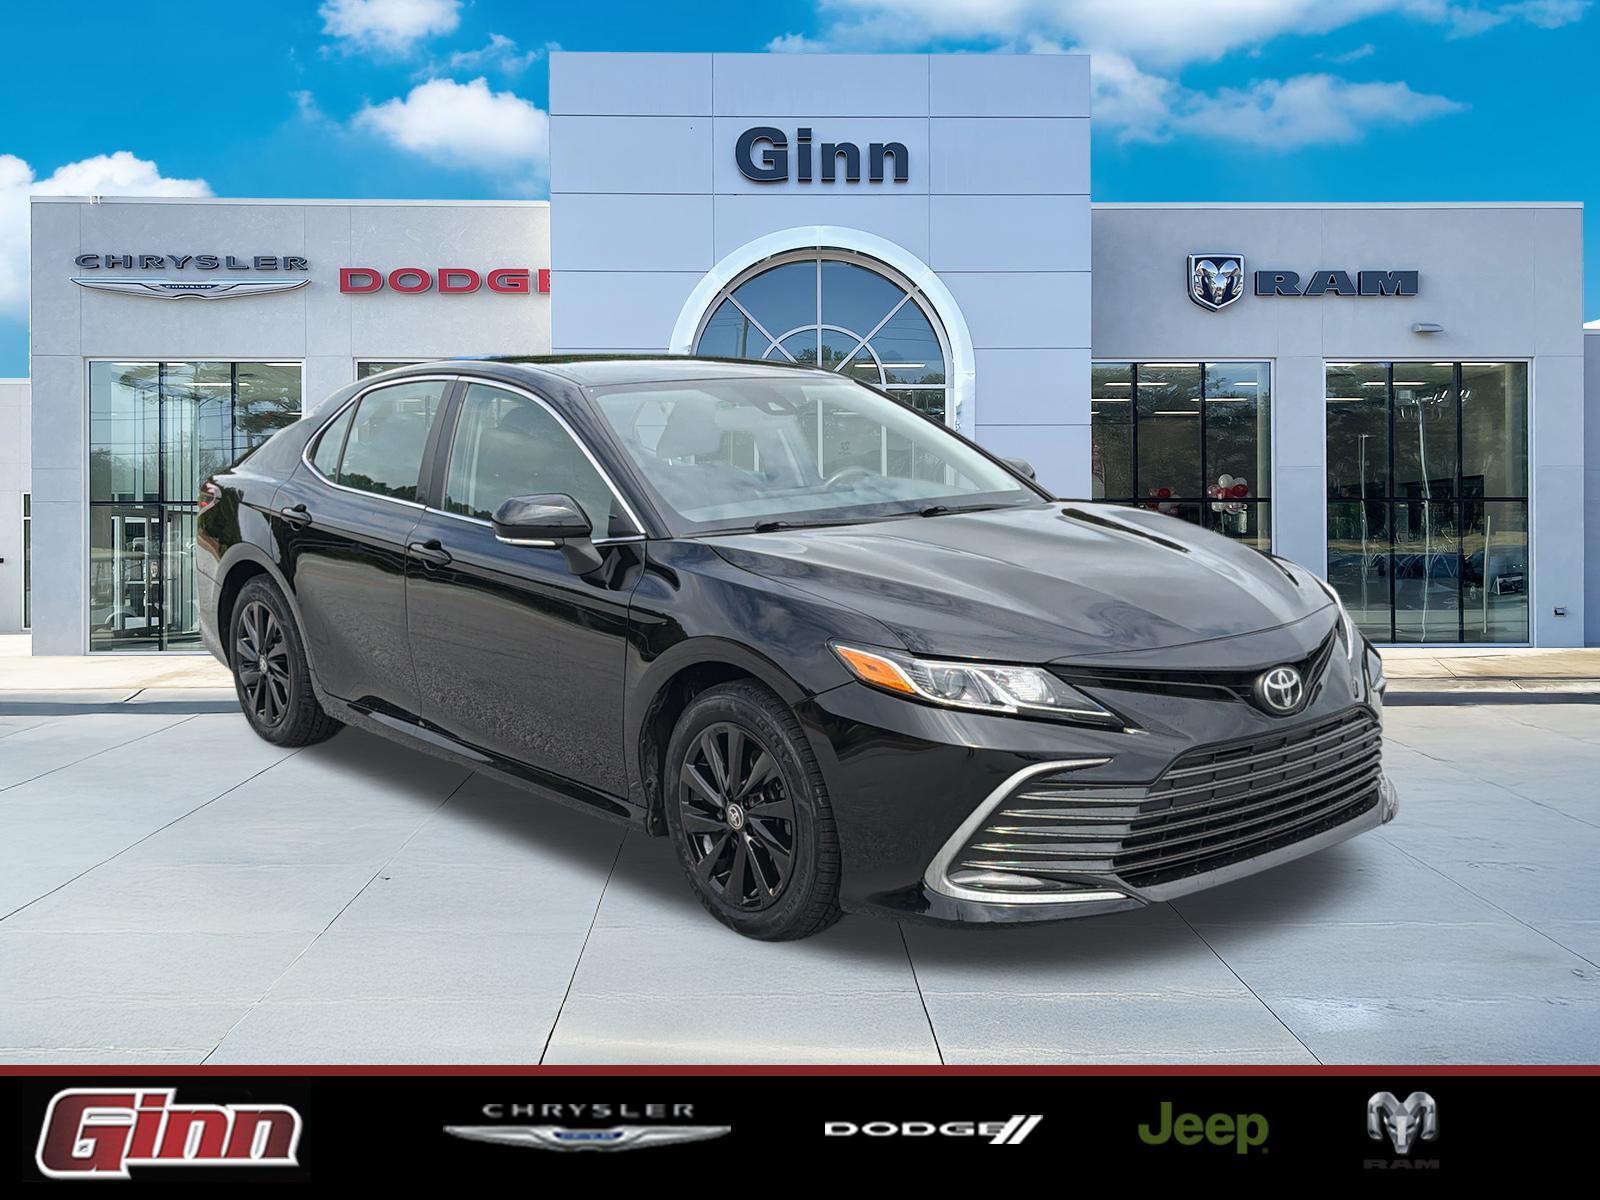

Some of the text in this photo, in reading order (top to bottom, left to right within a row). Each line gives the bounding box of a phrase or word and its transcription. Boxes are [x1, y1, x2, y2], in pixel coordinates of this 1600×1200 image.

[735, 126, 909, 183] Ginn
[74, 253, 309, 271] CHRYSLER
[1254, 270, 1419, 297] RAM
